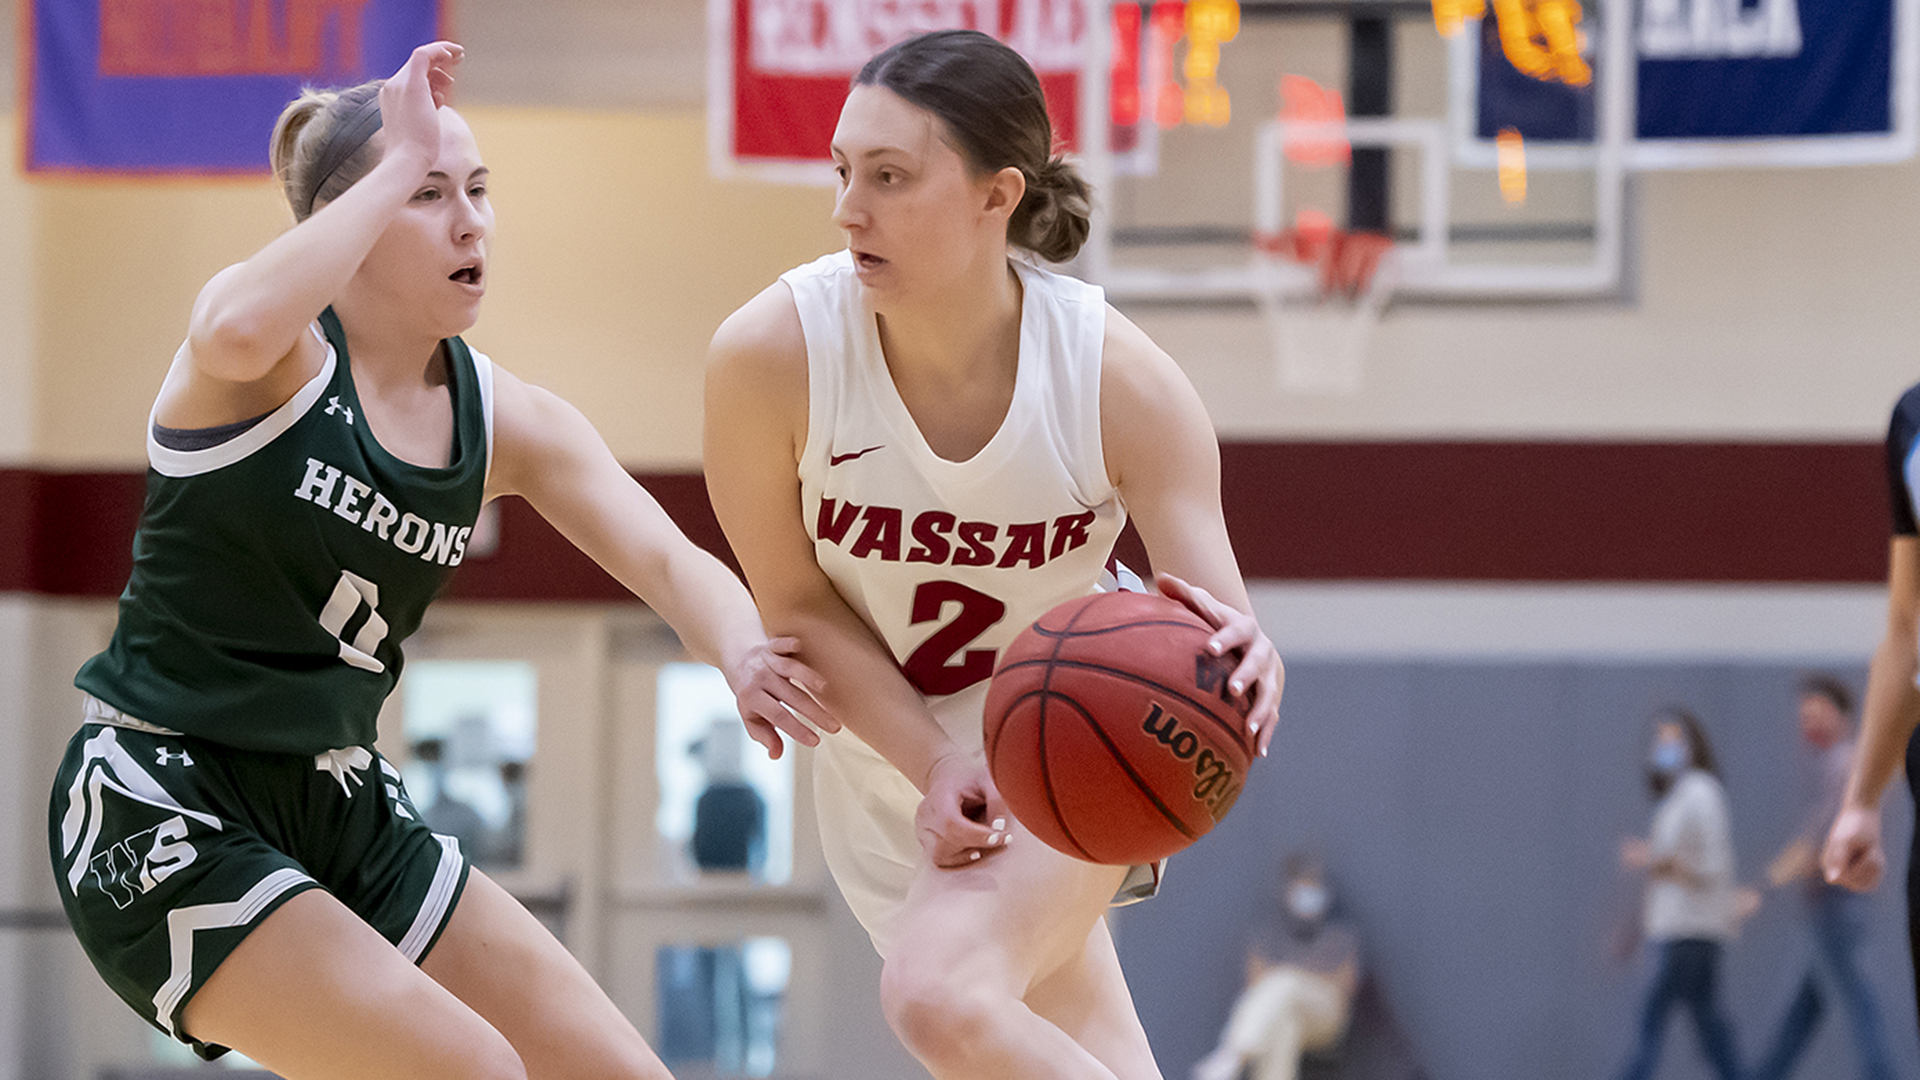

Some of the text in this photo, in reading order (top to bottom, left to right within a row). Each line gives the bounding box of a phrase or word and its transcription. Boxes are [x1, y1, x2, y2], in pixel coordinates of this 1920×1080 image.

[294, 457, 472, 567] HERONS
[816, 498, 1097, 570] VASSAR
[318, 569, 390, 673] 0
[902, 579, 1006, 697] 2
